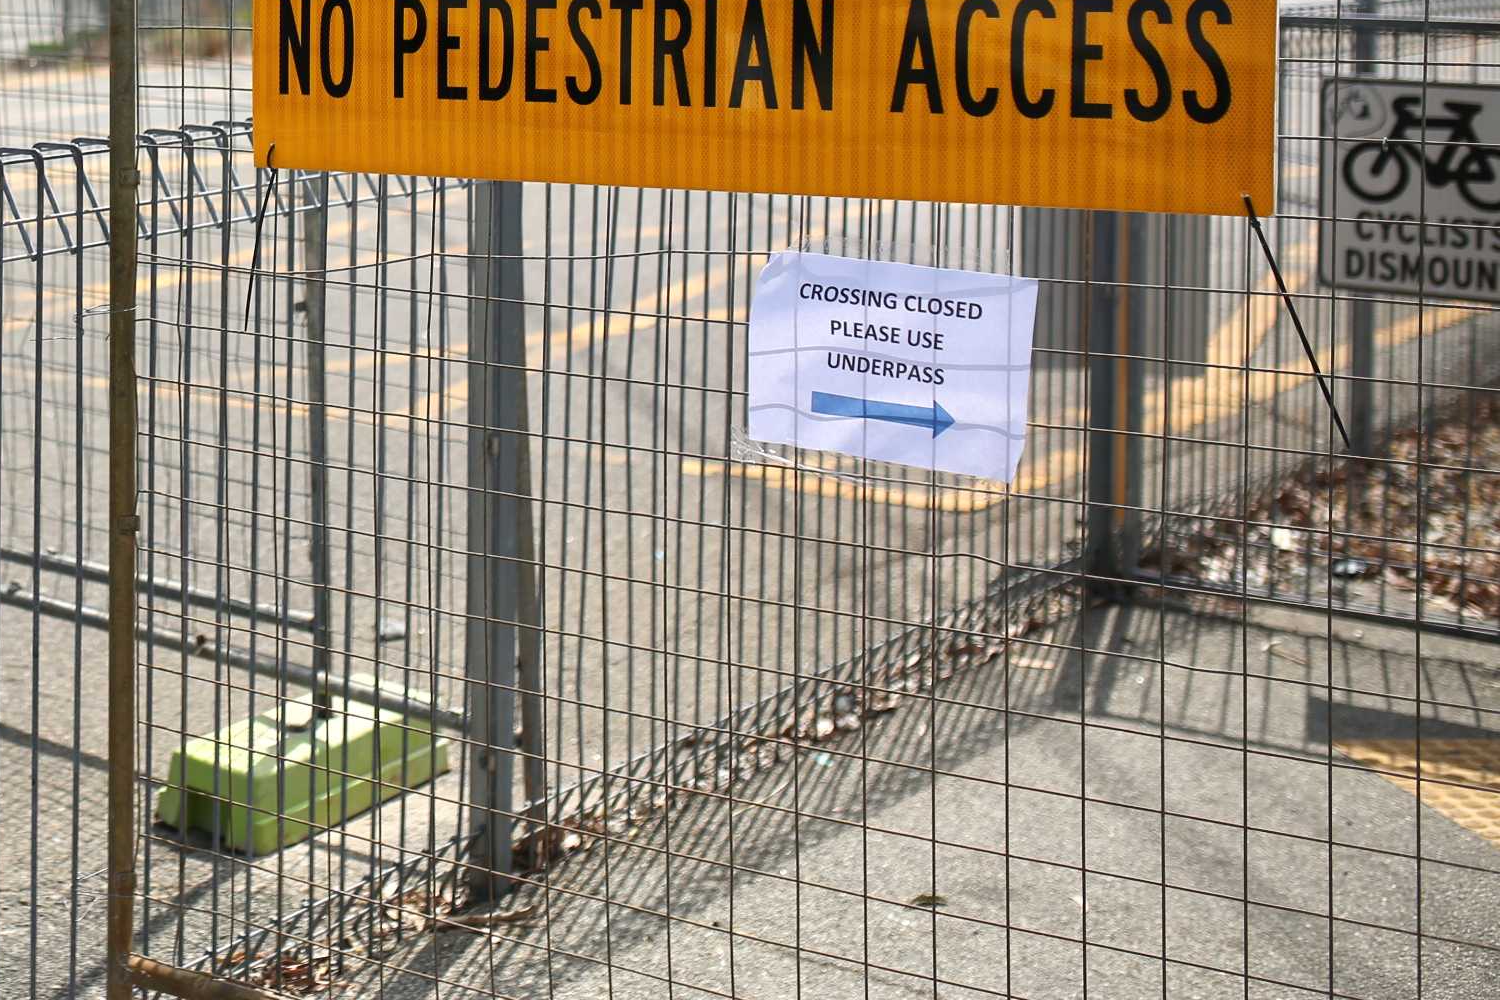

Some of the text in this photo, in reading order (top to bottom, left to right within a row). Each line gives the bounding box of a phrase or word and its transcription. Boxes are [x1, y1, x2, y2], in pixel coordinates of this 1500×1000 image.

[799, 281, 983, 321] CROSSING CLOSED
[829, 318, 945, 351] PLEASE USE
[826, 351, 946, 386] UNDERPASS
